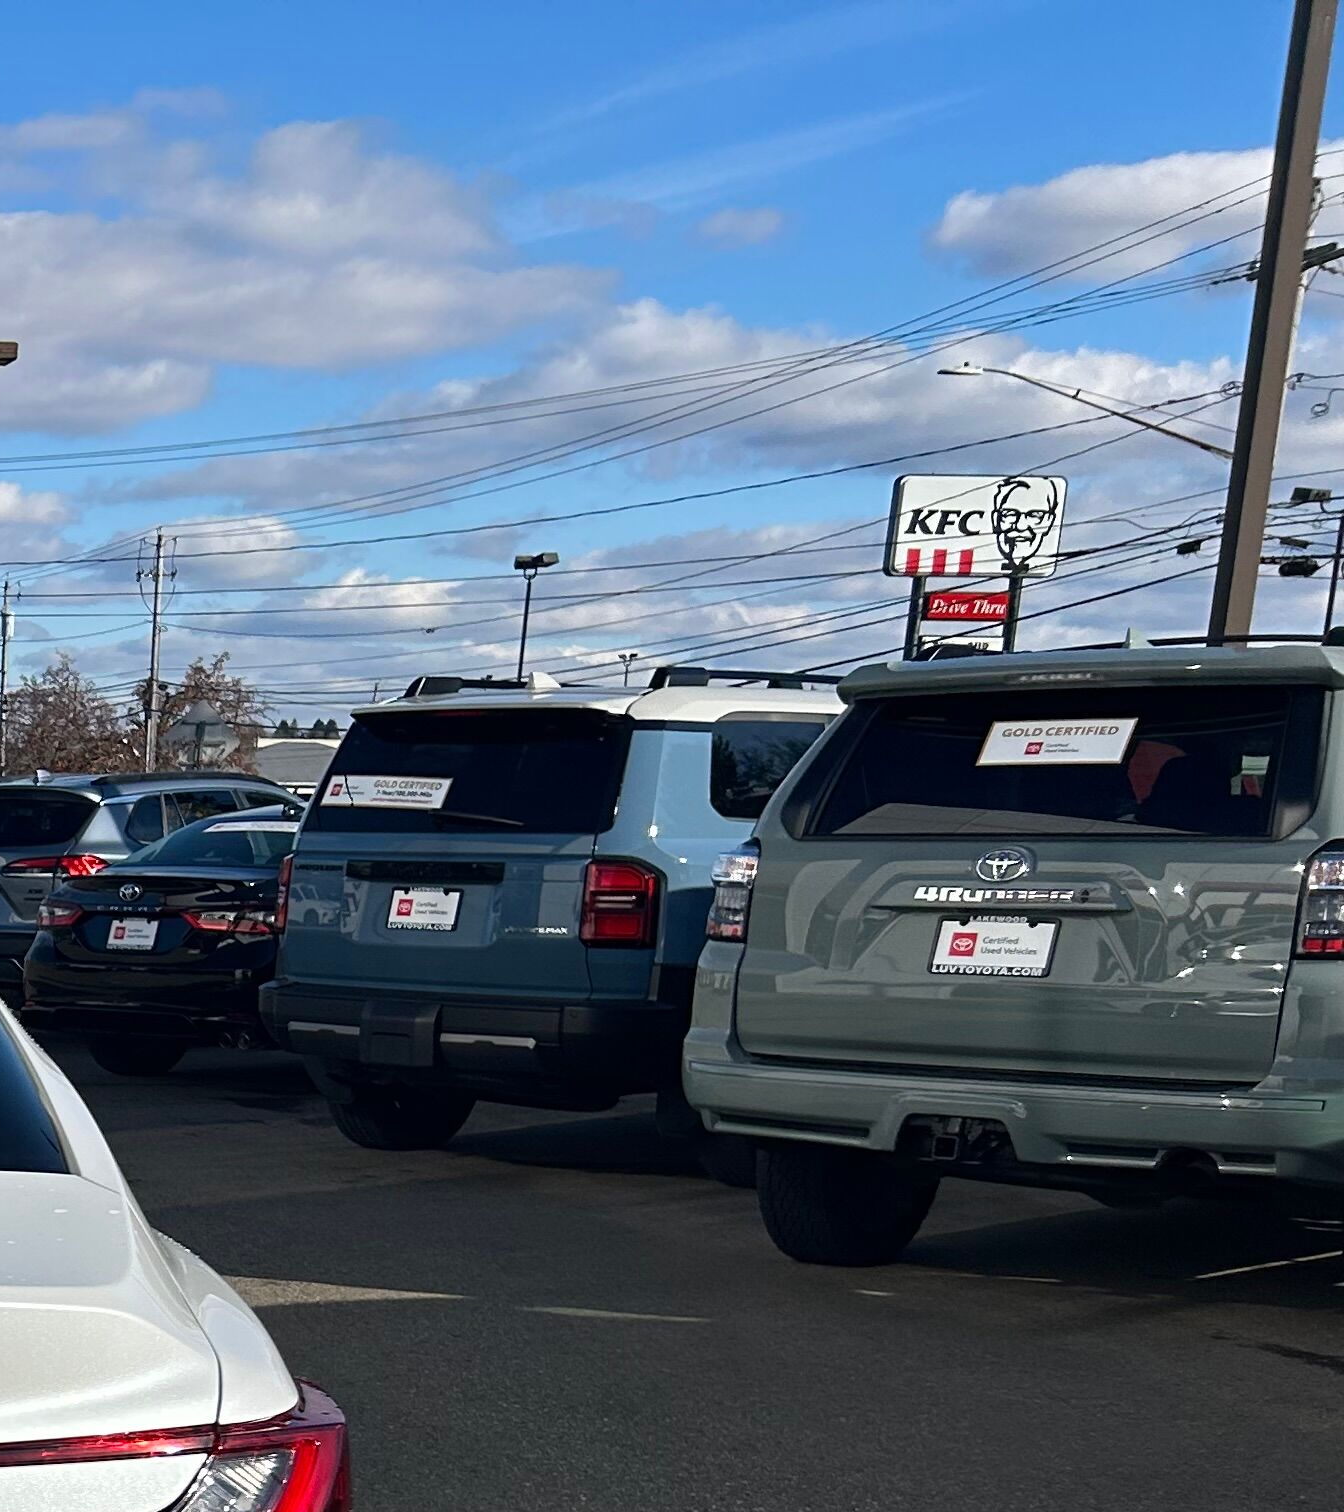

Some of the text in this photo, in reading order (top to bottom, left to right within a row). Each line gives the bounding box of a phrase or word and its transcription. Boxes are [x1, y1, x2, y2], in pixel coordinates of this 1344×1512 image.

[904, 509, 985, 535] KFC
[929, 599, 1007, 614] Drive Thru
[1002, 726, 1120, 738] GOLD CERTIFIED
[374, 779, 443, 791] GOLD CERTIFIED
[970, 915, 1028, 923] LAKEWOOD
[982, 936, 1019, 944] Certified
[980, 946, 1038, 955] Used Vehicles
[931, 964, 1043, 977] LUVTOYOTA.COM
